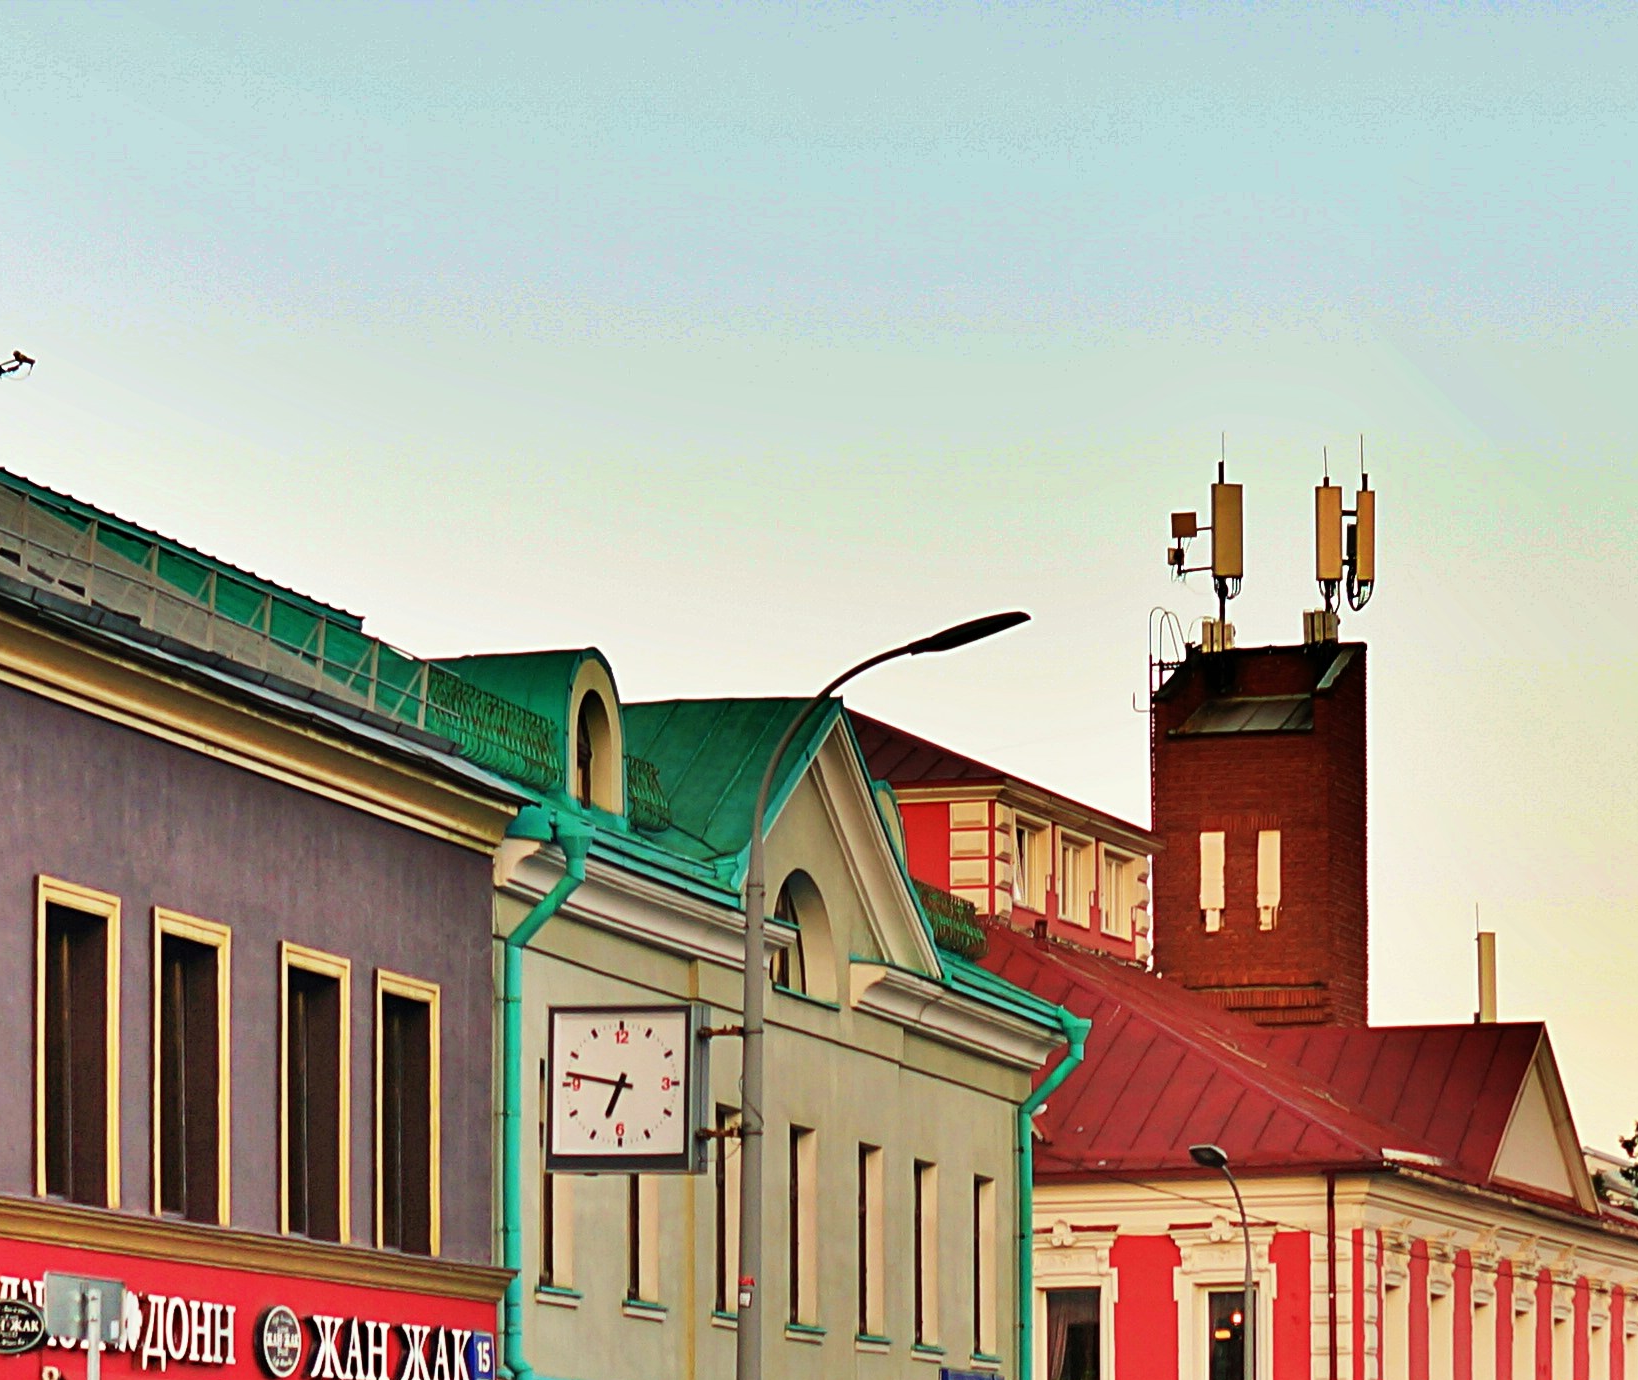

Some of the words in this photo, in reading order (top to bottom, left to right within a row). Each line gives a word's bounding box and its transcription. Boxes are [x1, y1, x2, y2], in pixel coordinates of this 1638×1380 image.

[615, 1030, 629, 1044] 12
[572, 1076, 581, 1091] 9
[661, 1077, 671, 1091] 3
[615, 1123, 625, 1137] 6
[10, 1319, 39, 1333] ЖАК
[142, 1294, 237, 1372] ДОНН
[477, 1341, 491, 1373] 15
